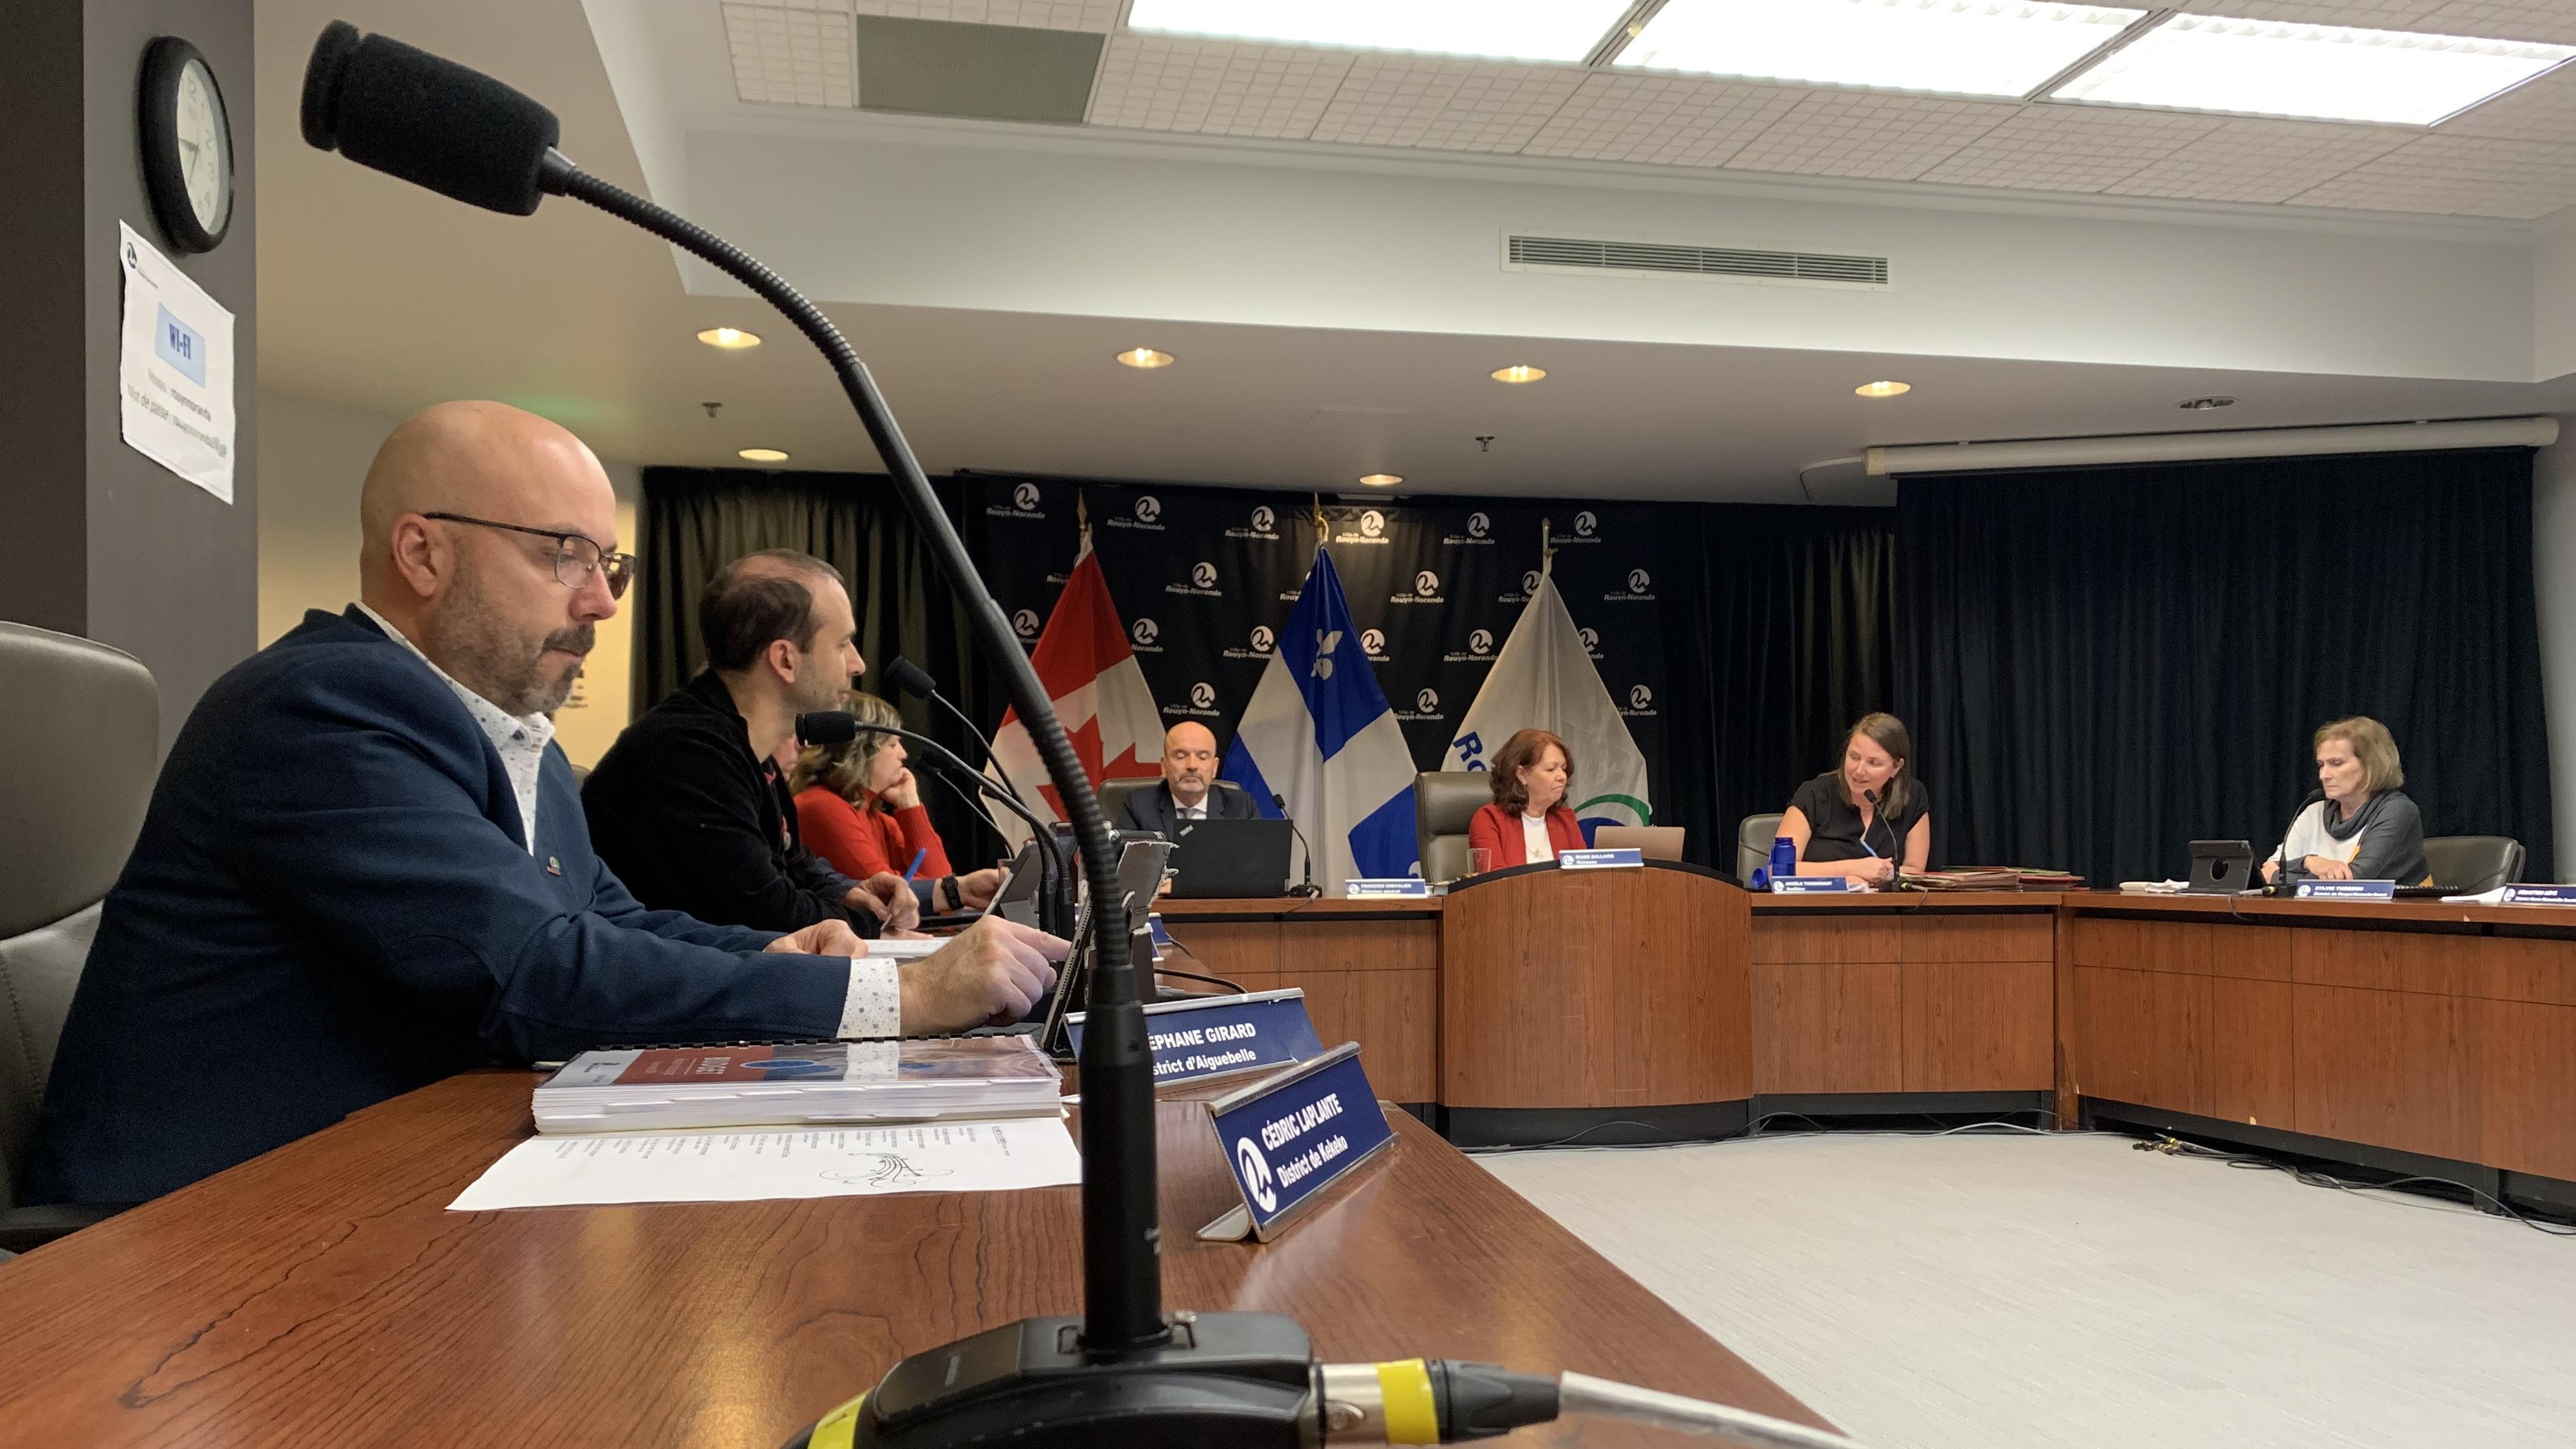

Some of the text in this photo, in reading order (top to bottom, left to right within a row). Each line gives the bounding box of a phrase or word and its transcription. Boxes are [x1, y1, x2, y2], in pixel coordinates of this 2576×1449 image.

[169, 323, 191, 360] WI-FI
[986, 507, 1045, 519] Rouyn-Noranda
[1107, 519, 1165, 531] Rouyn-Noranda
[1225, 530, 1280, 540] Rouyn-Noranda
[1165, 585, 1222, 597] Rouyn-Noranda
[1390, 595, 1445, 604] Rouyn-Noranda
[1131, 643, 1163, 653] Noranda
[1223, 650, 1273, 659] Rouyn-Noran
[1163, 707, 1220, 716] Rouyn-Noranda
[1149, 1023, 1257, 1051] ÉPHANE GIRARD
[1153, 1048, 1257, 1076] strict d'Aiguebelle
[1261, 1093, 1343, 1151] CÉDRIC LAPLANTE
[1276, 1135, 1349, 1188] District de Kekeko
